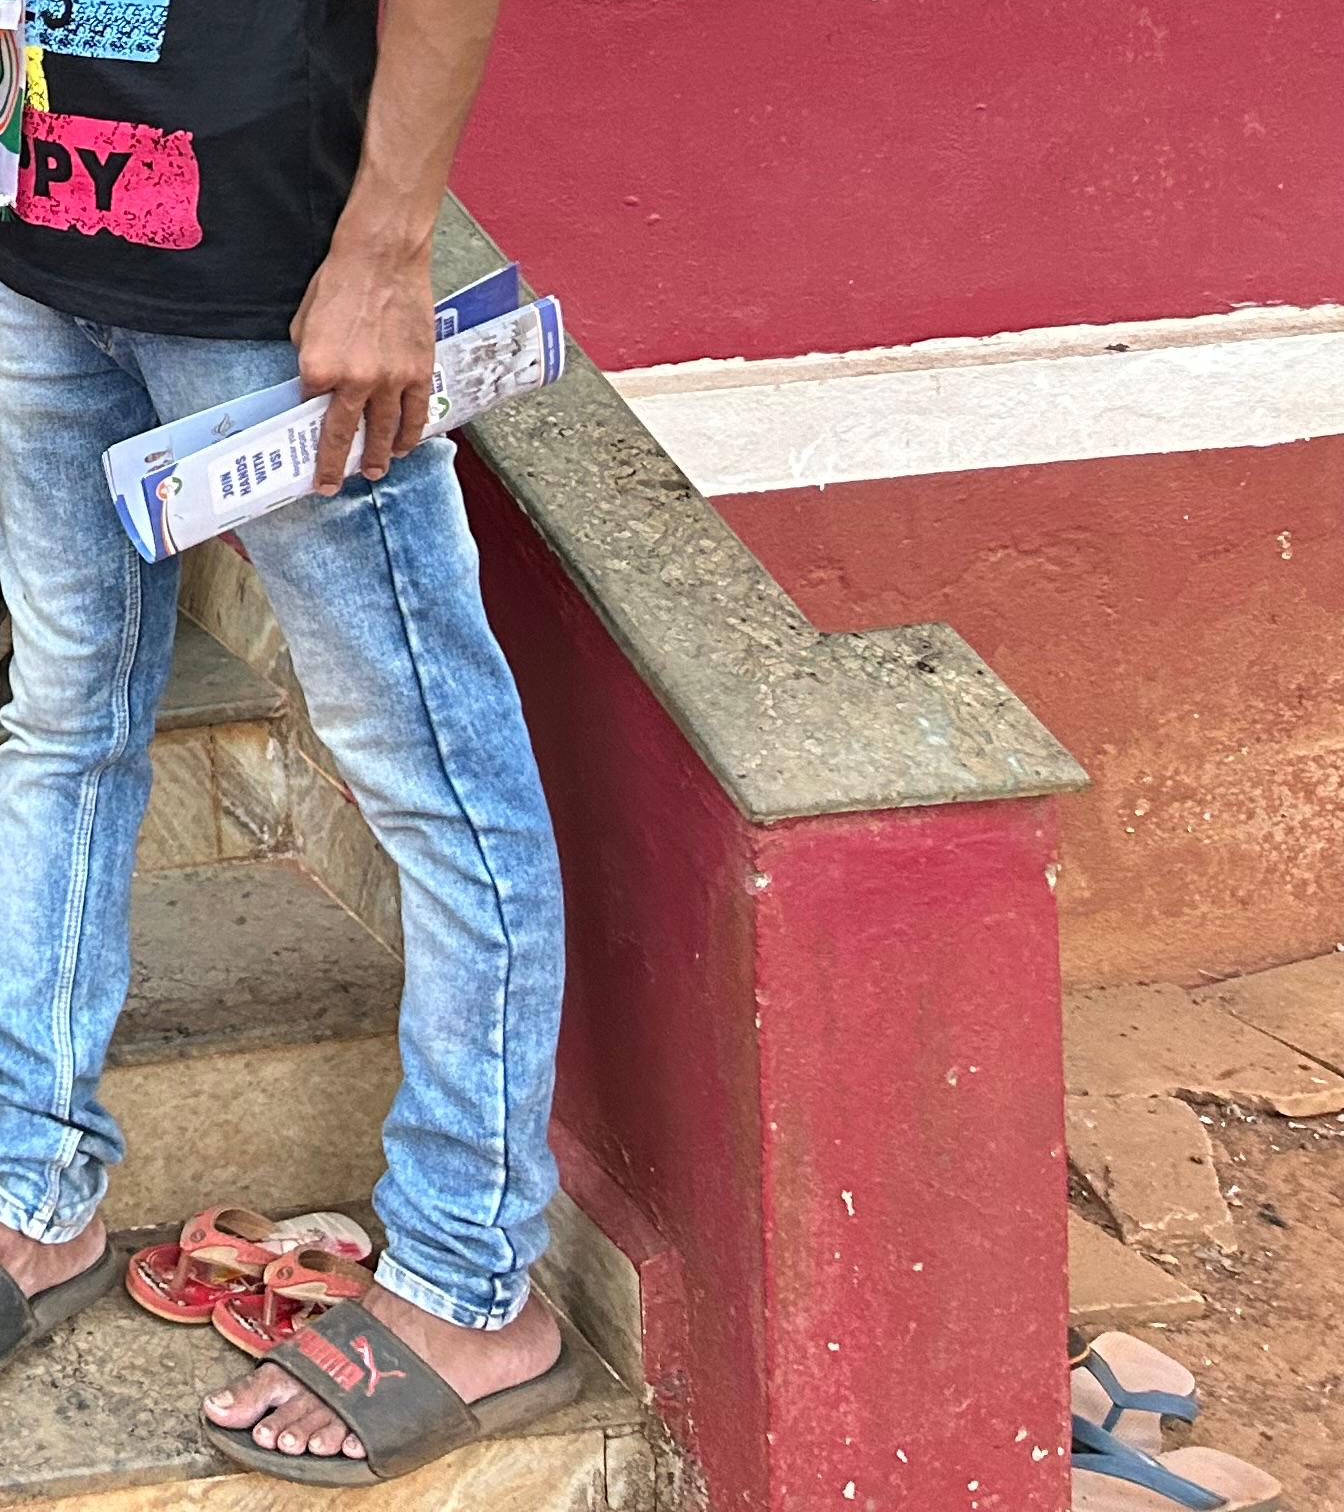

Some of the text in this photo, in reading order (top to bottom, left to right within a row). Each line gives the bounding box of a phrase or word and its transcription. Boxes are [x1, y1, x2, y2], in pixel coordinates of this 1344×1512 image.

[252, 451, 268, 486] WITH
[269, 448, 283, 471] US!
[220, 471, 235, 499] JOIN
[235, 455, 252, 497] HANDS
